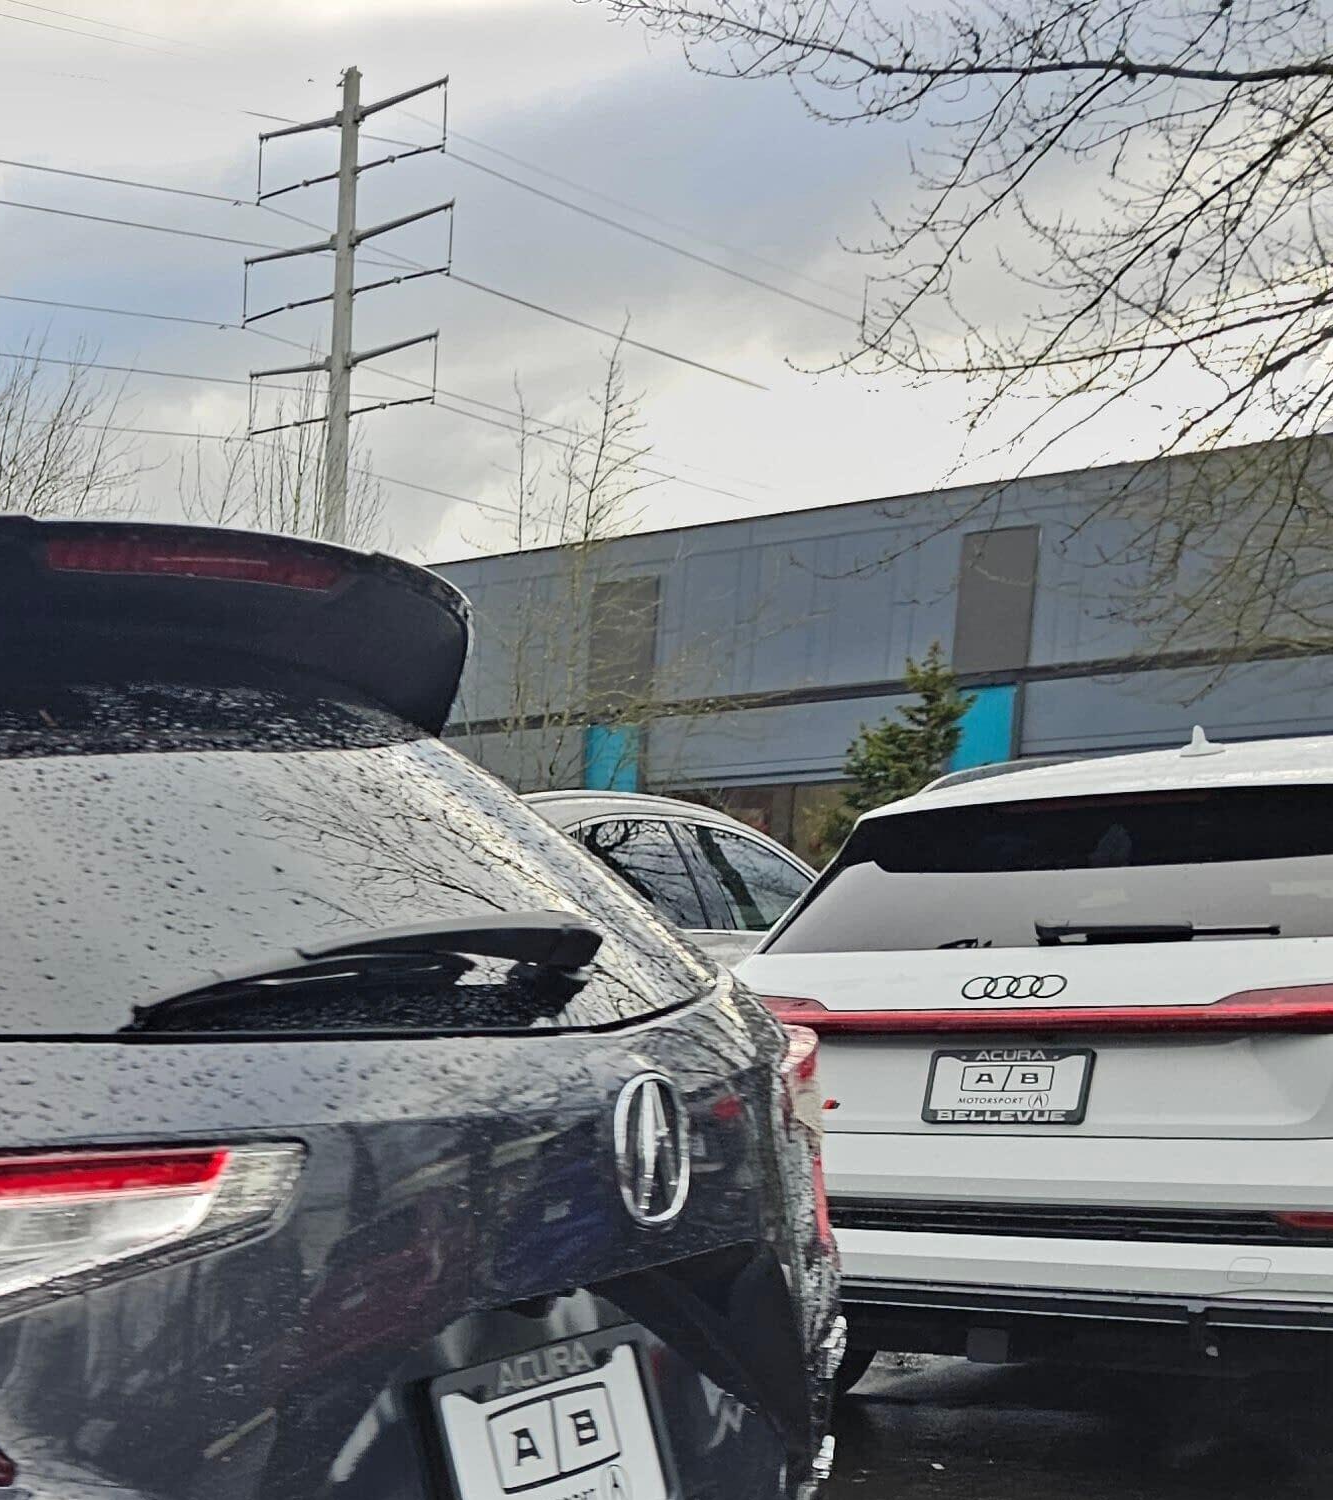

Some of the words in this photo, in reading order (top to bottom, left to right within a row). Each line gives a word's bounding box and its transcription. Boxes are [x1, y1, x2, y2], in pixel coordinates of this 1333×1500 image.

[975, 1050, 1046, 1062] ACURA
[975, 1073, 994, 1084] A
[1020, 1072, 1039, 1084] B
[957, 1096, 1024, 1105] MOTORSPORT
[936, 1110, 1066, 1122] BELLEVUE
[497, 1341, 596, 1394] ACURA
[510, 1428, 542, 1466] A
[567, 1408, 599, 1446] B
